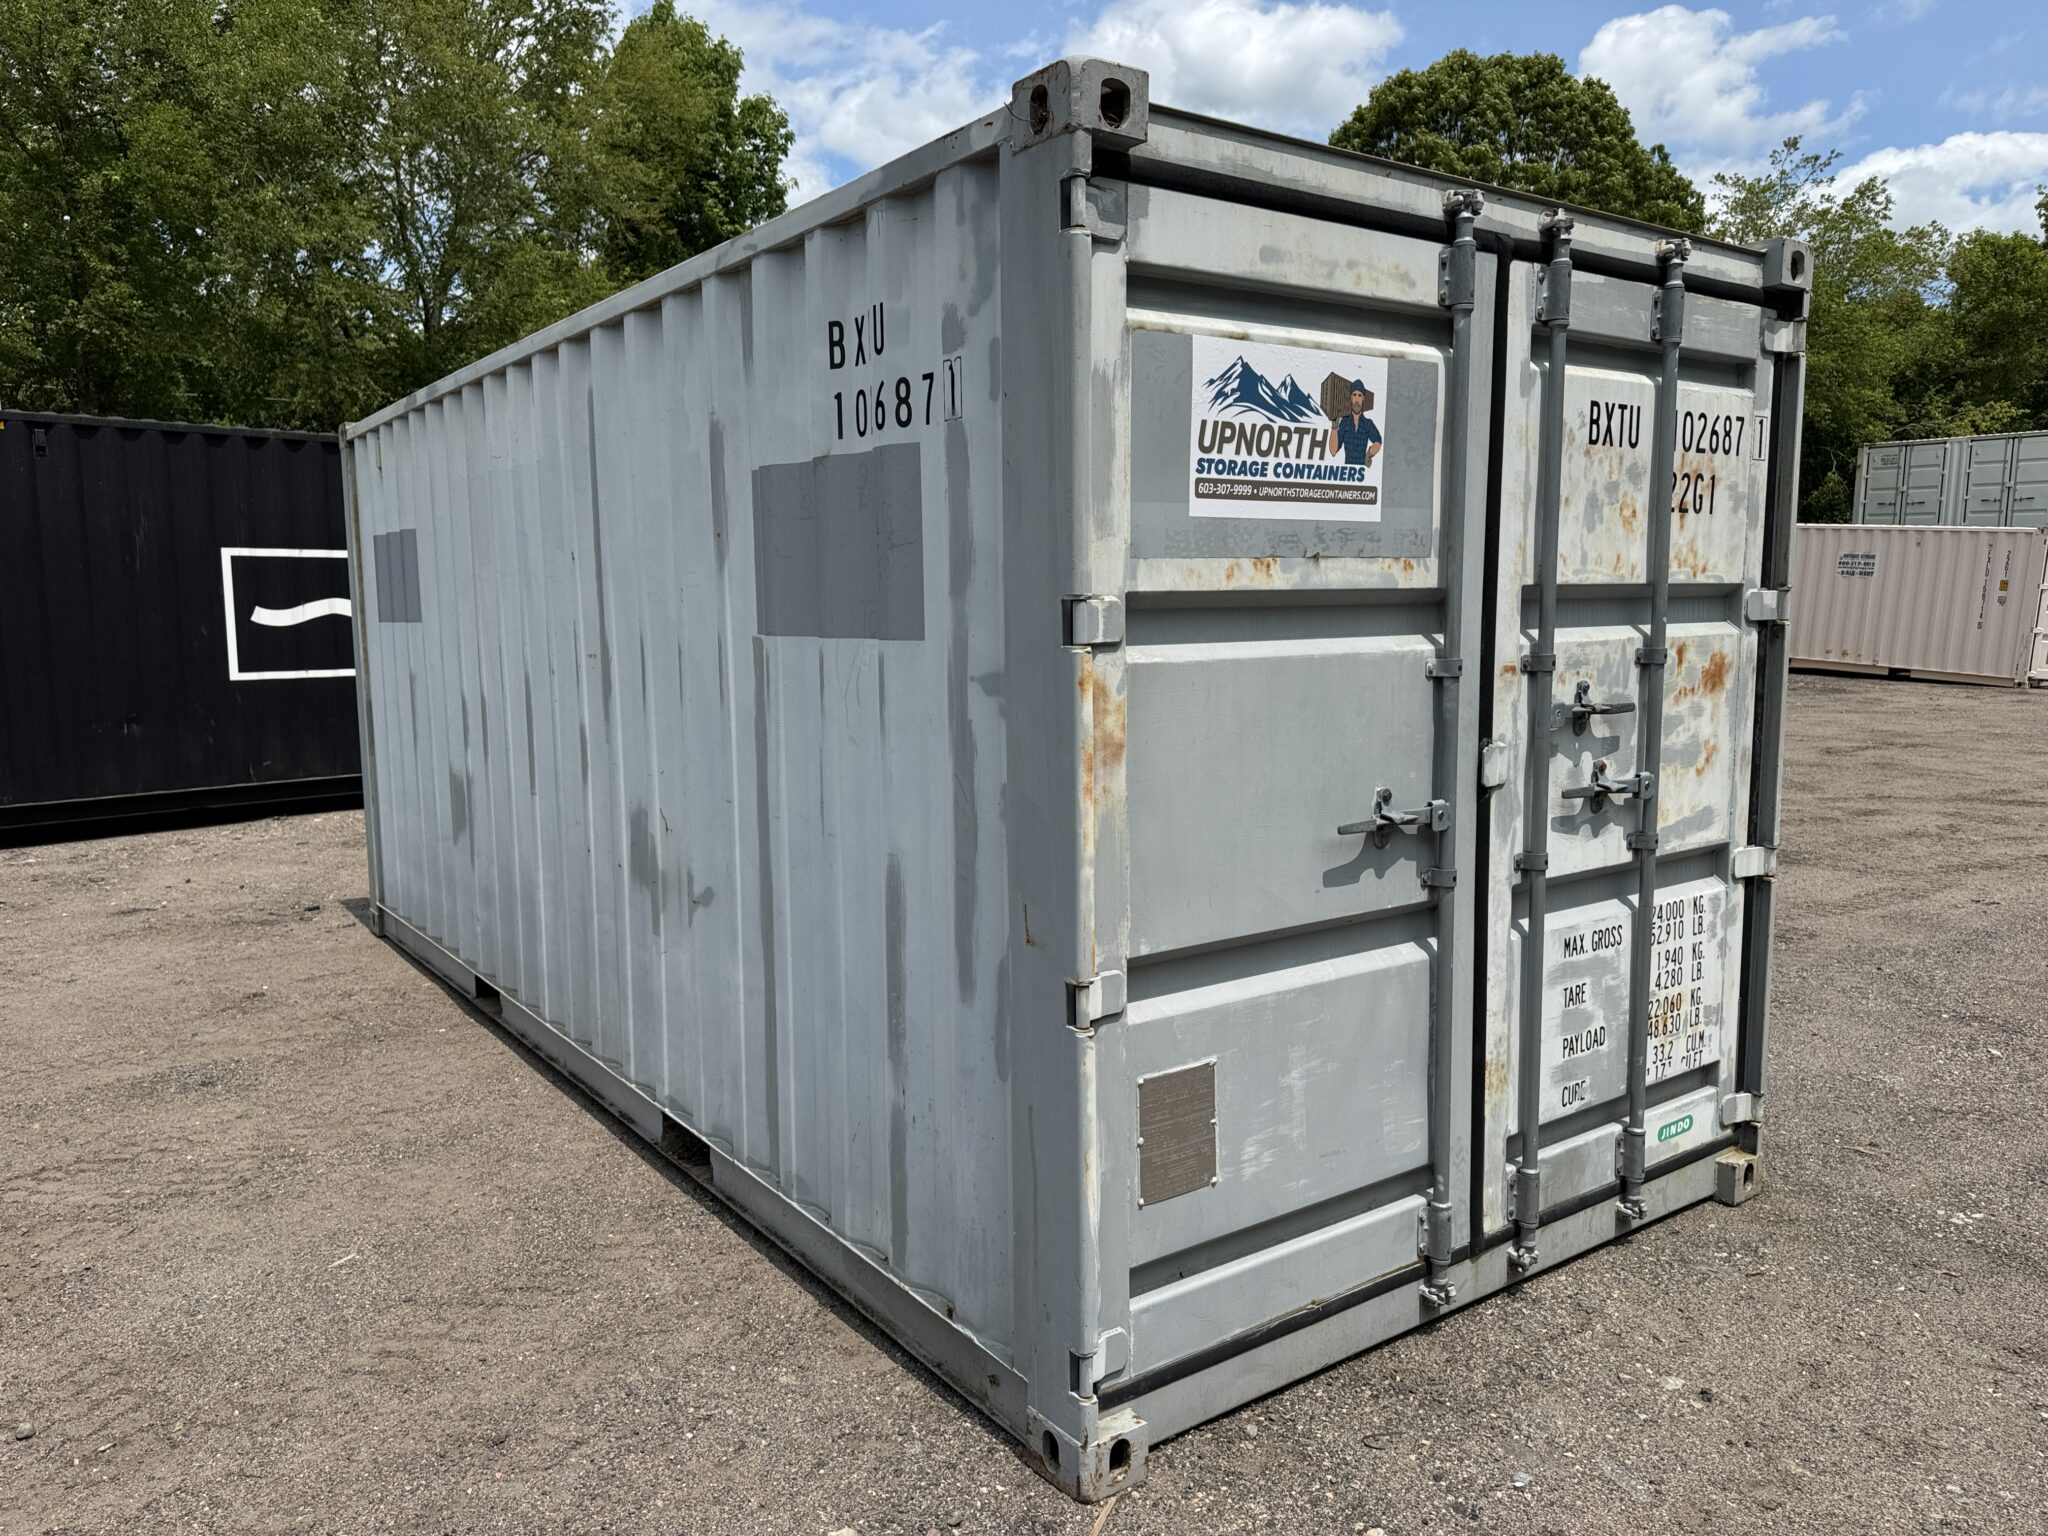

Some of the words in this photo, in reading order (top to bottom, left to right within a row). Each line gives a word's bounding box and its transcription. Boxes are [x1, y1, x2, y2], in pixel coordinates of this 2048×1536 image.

[1588, 400, 1641, 449] BXTU
[1198, 419, 1329, 461] UPNORTH
[1195, 457, 1269, 478] STORAGE
[1273, 462, 1366, 483] CONTAINERS
[1198, 482, 1252, 496] 603-307-9999
[1258, 487, 1376, 501] UPNORTHSTORAGECONTAINERS.COM
[1693, 895, 1706, 915] KG.
[1693, 915, 1705, 936] LB.
[1564, 934, 1588, 959] MAX.
[1592, 924, 1622, 952] GROSS
[1692, 941, 1705, 961] KG.
[1692, 961, 1704, 982] LB.
[1564, 982, 1587, 1009] TARE
[1690, 987, 1703, 1007] KG.
[1690, 1007, 1702, 1027] LB.
[1563, 1025, 1606, 1059] PAYLOAD
[1653, 1040, 1673, 1064] 33.2
[1661, 1118, 1690, 1140] JINDO
